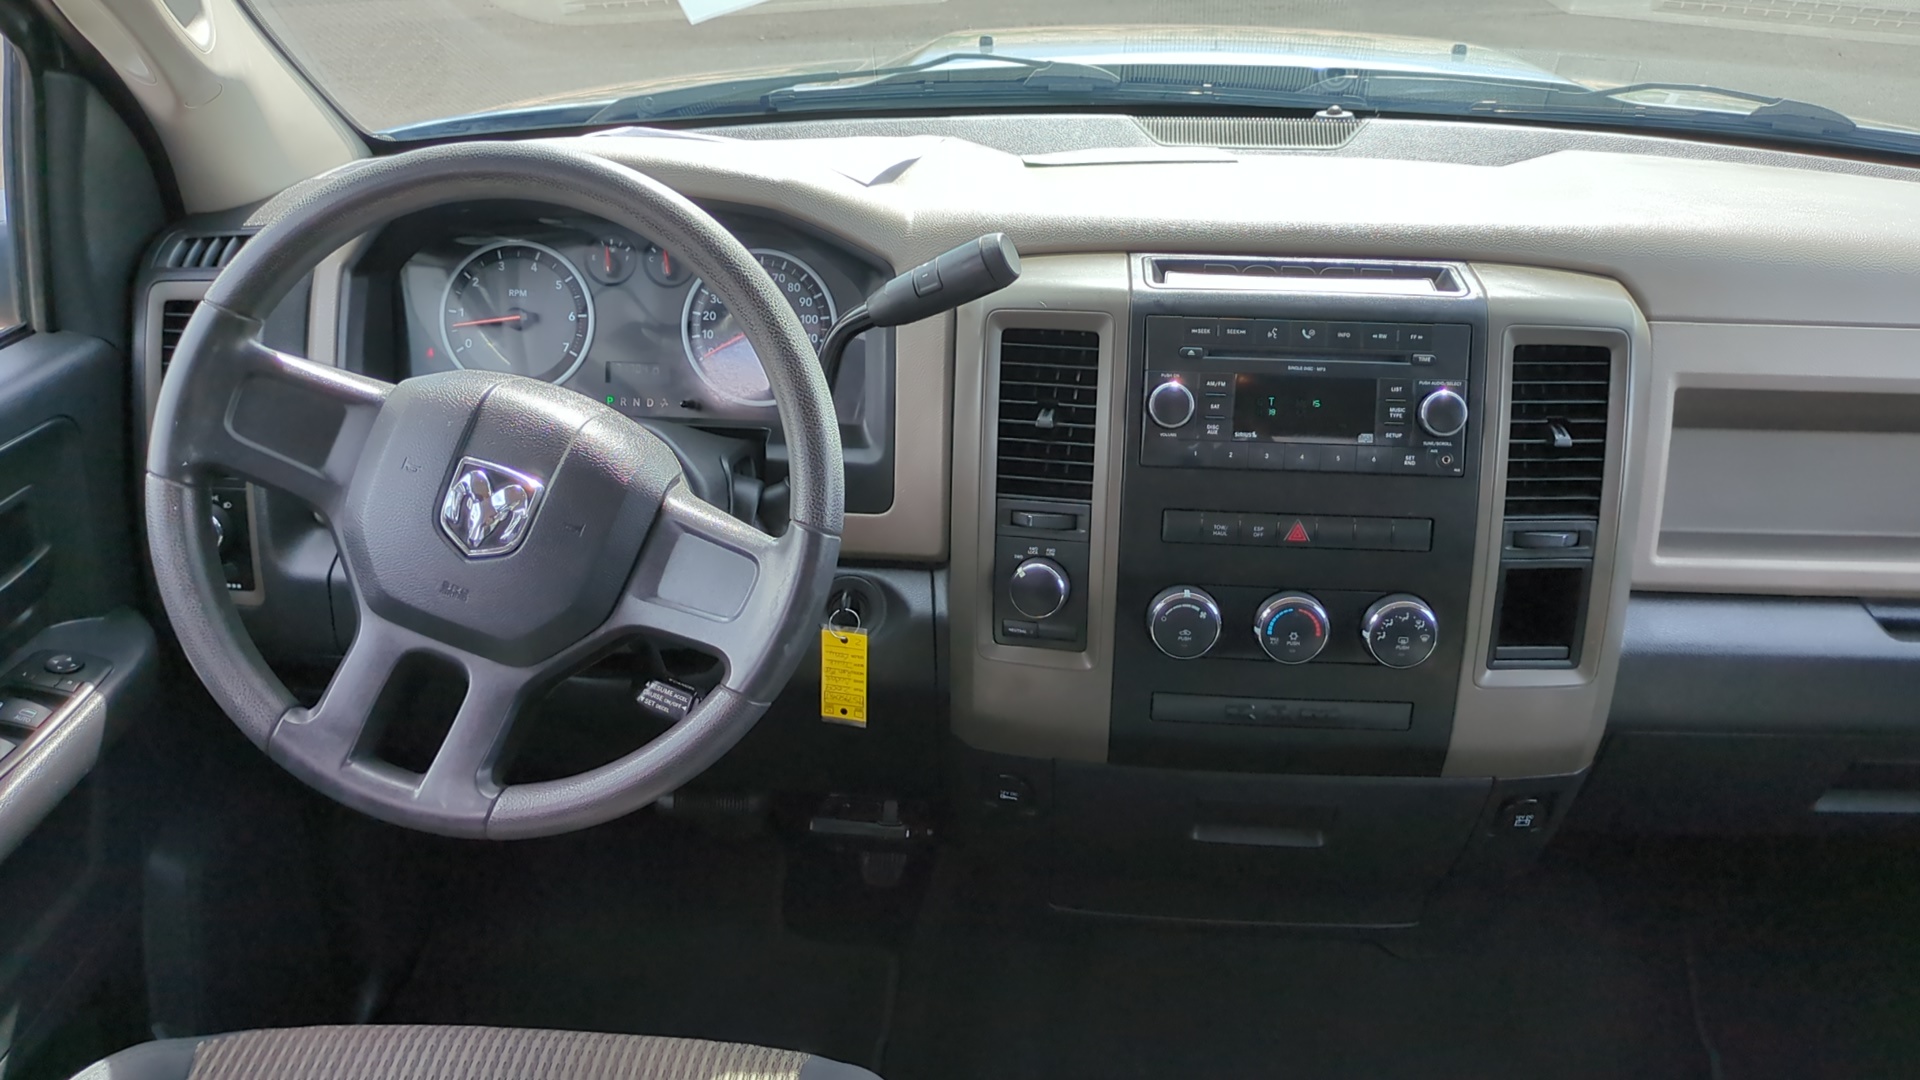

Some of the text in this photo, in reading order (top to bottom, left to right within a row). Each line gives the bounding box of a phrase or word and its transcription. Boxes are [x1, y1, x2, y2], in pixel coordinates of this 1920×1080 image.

[498, 261, 506, 272] 3
[530, 261, 538, 272] 4
[472, 277, 480, 288] 2
[772, 273, 785, 283] 70
[555, 281, 563, 291] 5
[787, 282, 801, 293] 80
[508, 289, 528, 298] RPM
[799, 297, 813, 307] 90
[458, 308, 465, 317] 1
[568, 311, 576, 322] 6
[702, 310, 717, 321] 20
[801, 314, 819, 325] 100
[701, 329, 714, 340] 10
[465, 338, 473, 349] 0
[563, 343, 570, 353] 7
[606, 395, 655, 408] P R N D
[644, 697, 656, 707] SET
